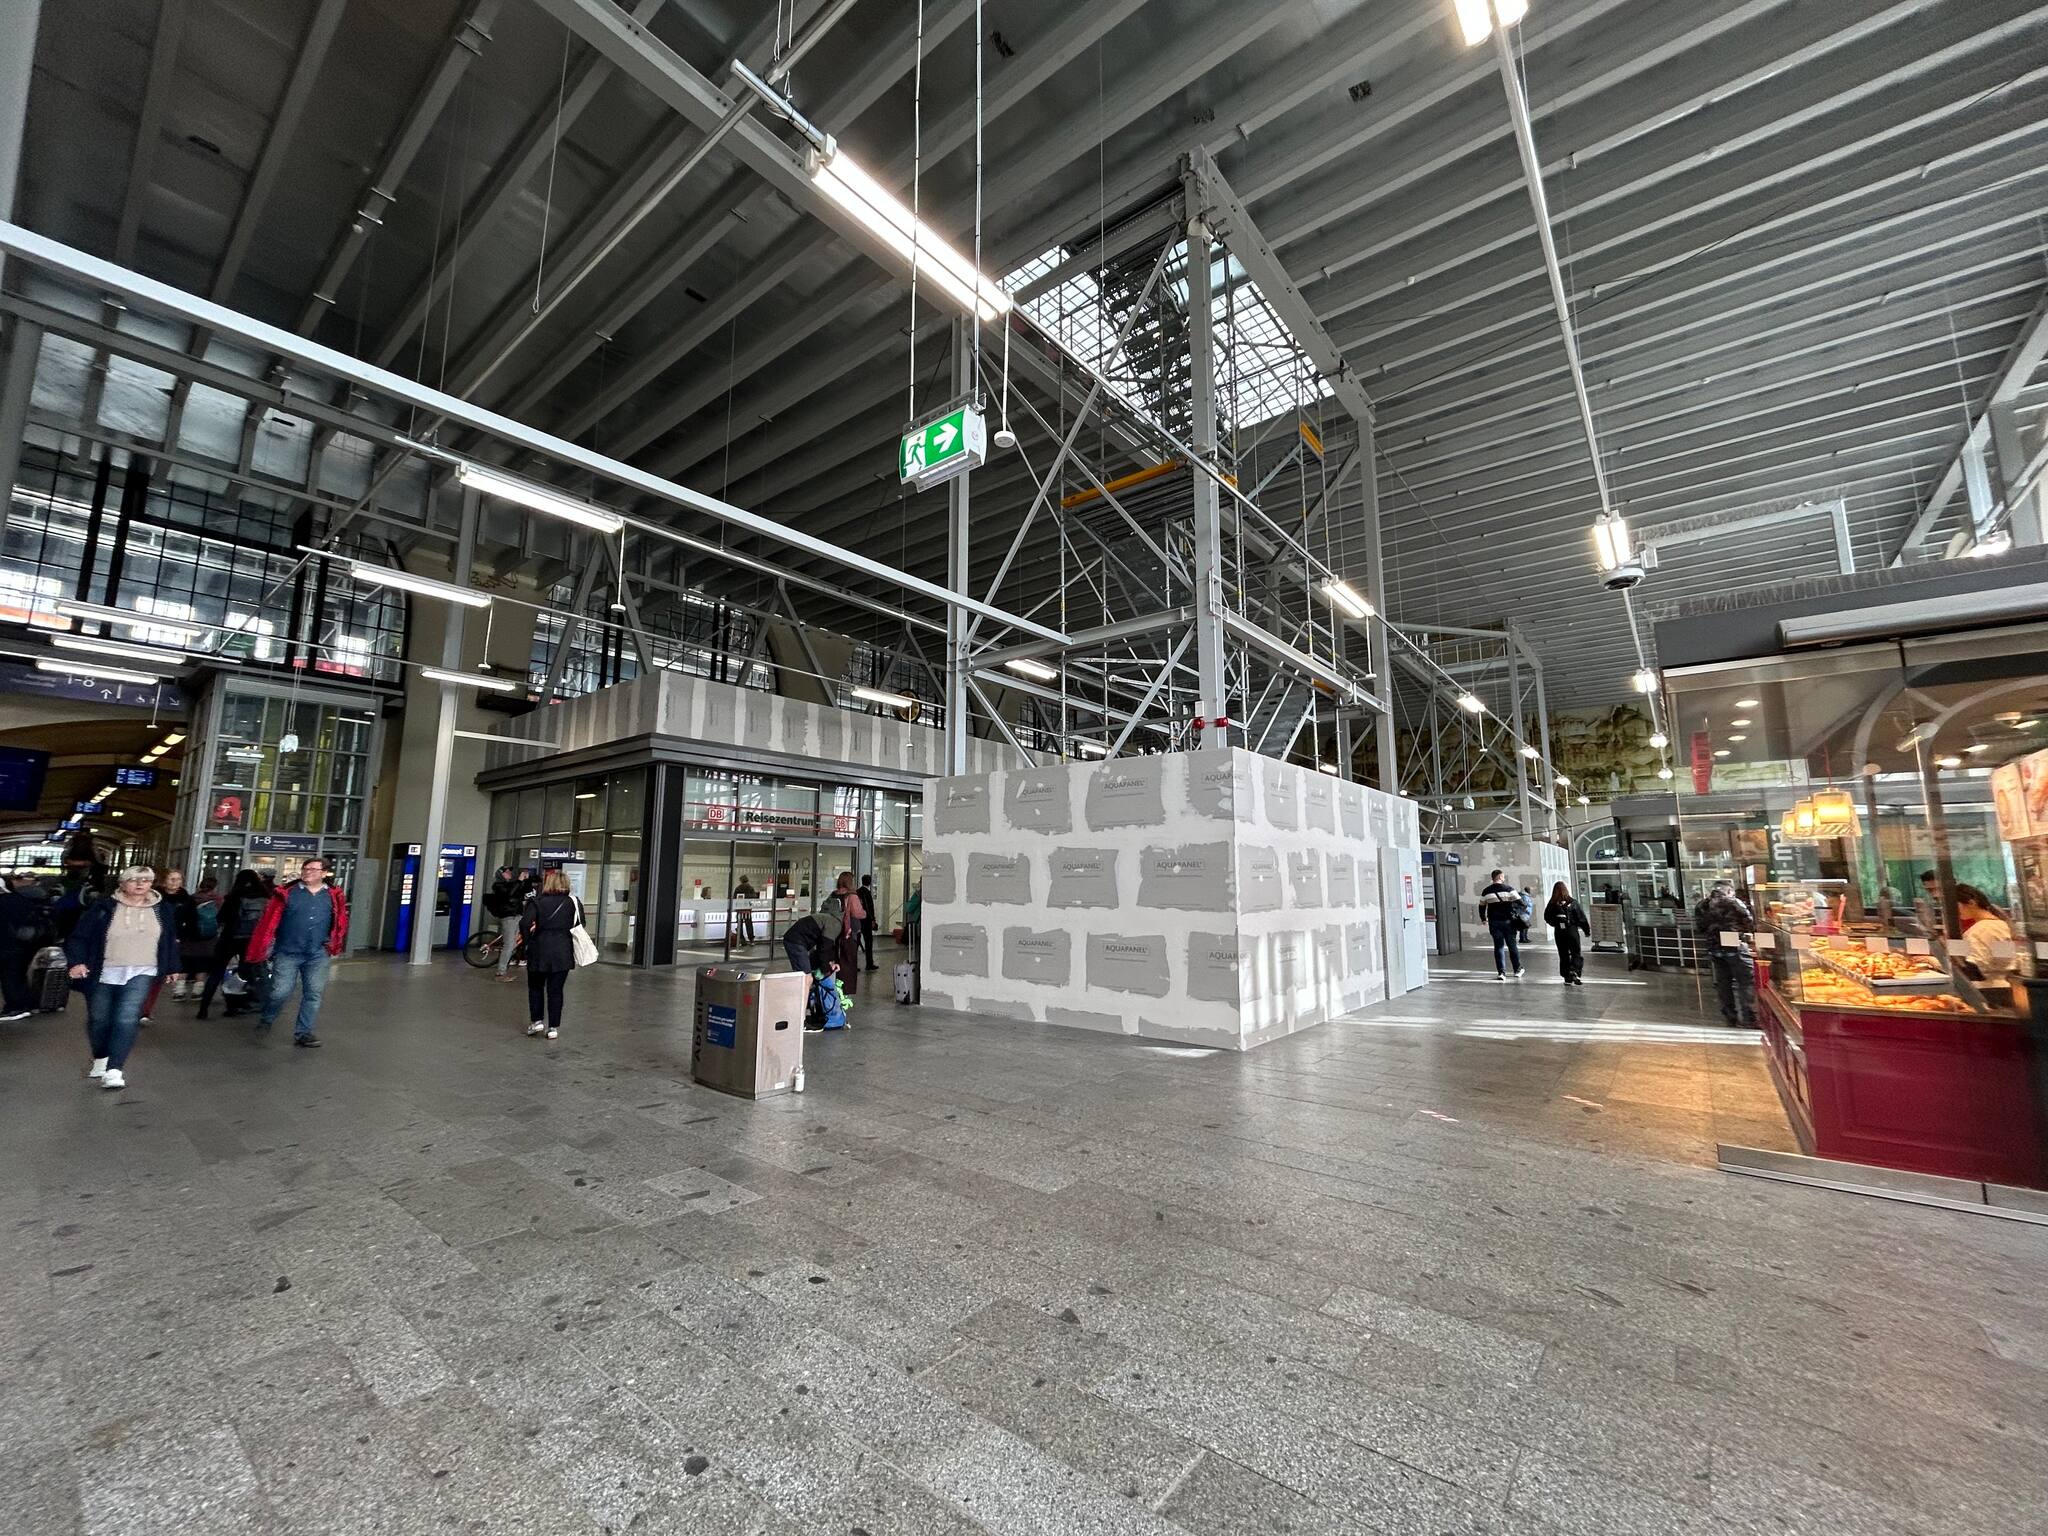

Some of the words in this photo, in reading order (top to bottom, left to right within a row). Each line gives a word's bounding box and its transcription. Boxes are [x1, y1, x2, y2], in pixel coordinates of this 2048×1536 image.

[709, 808, 723, 819] DB
[746, 811, 816, 826] Reisezentrum
[253, 836, 272, 845] 1-8
